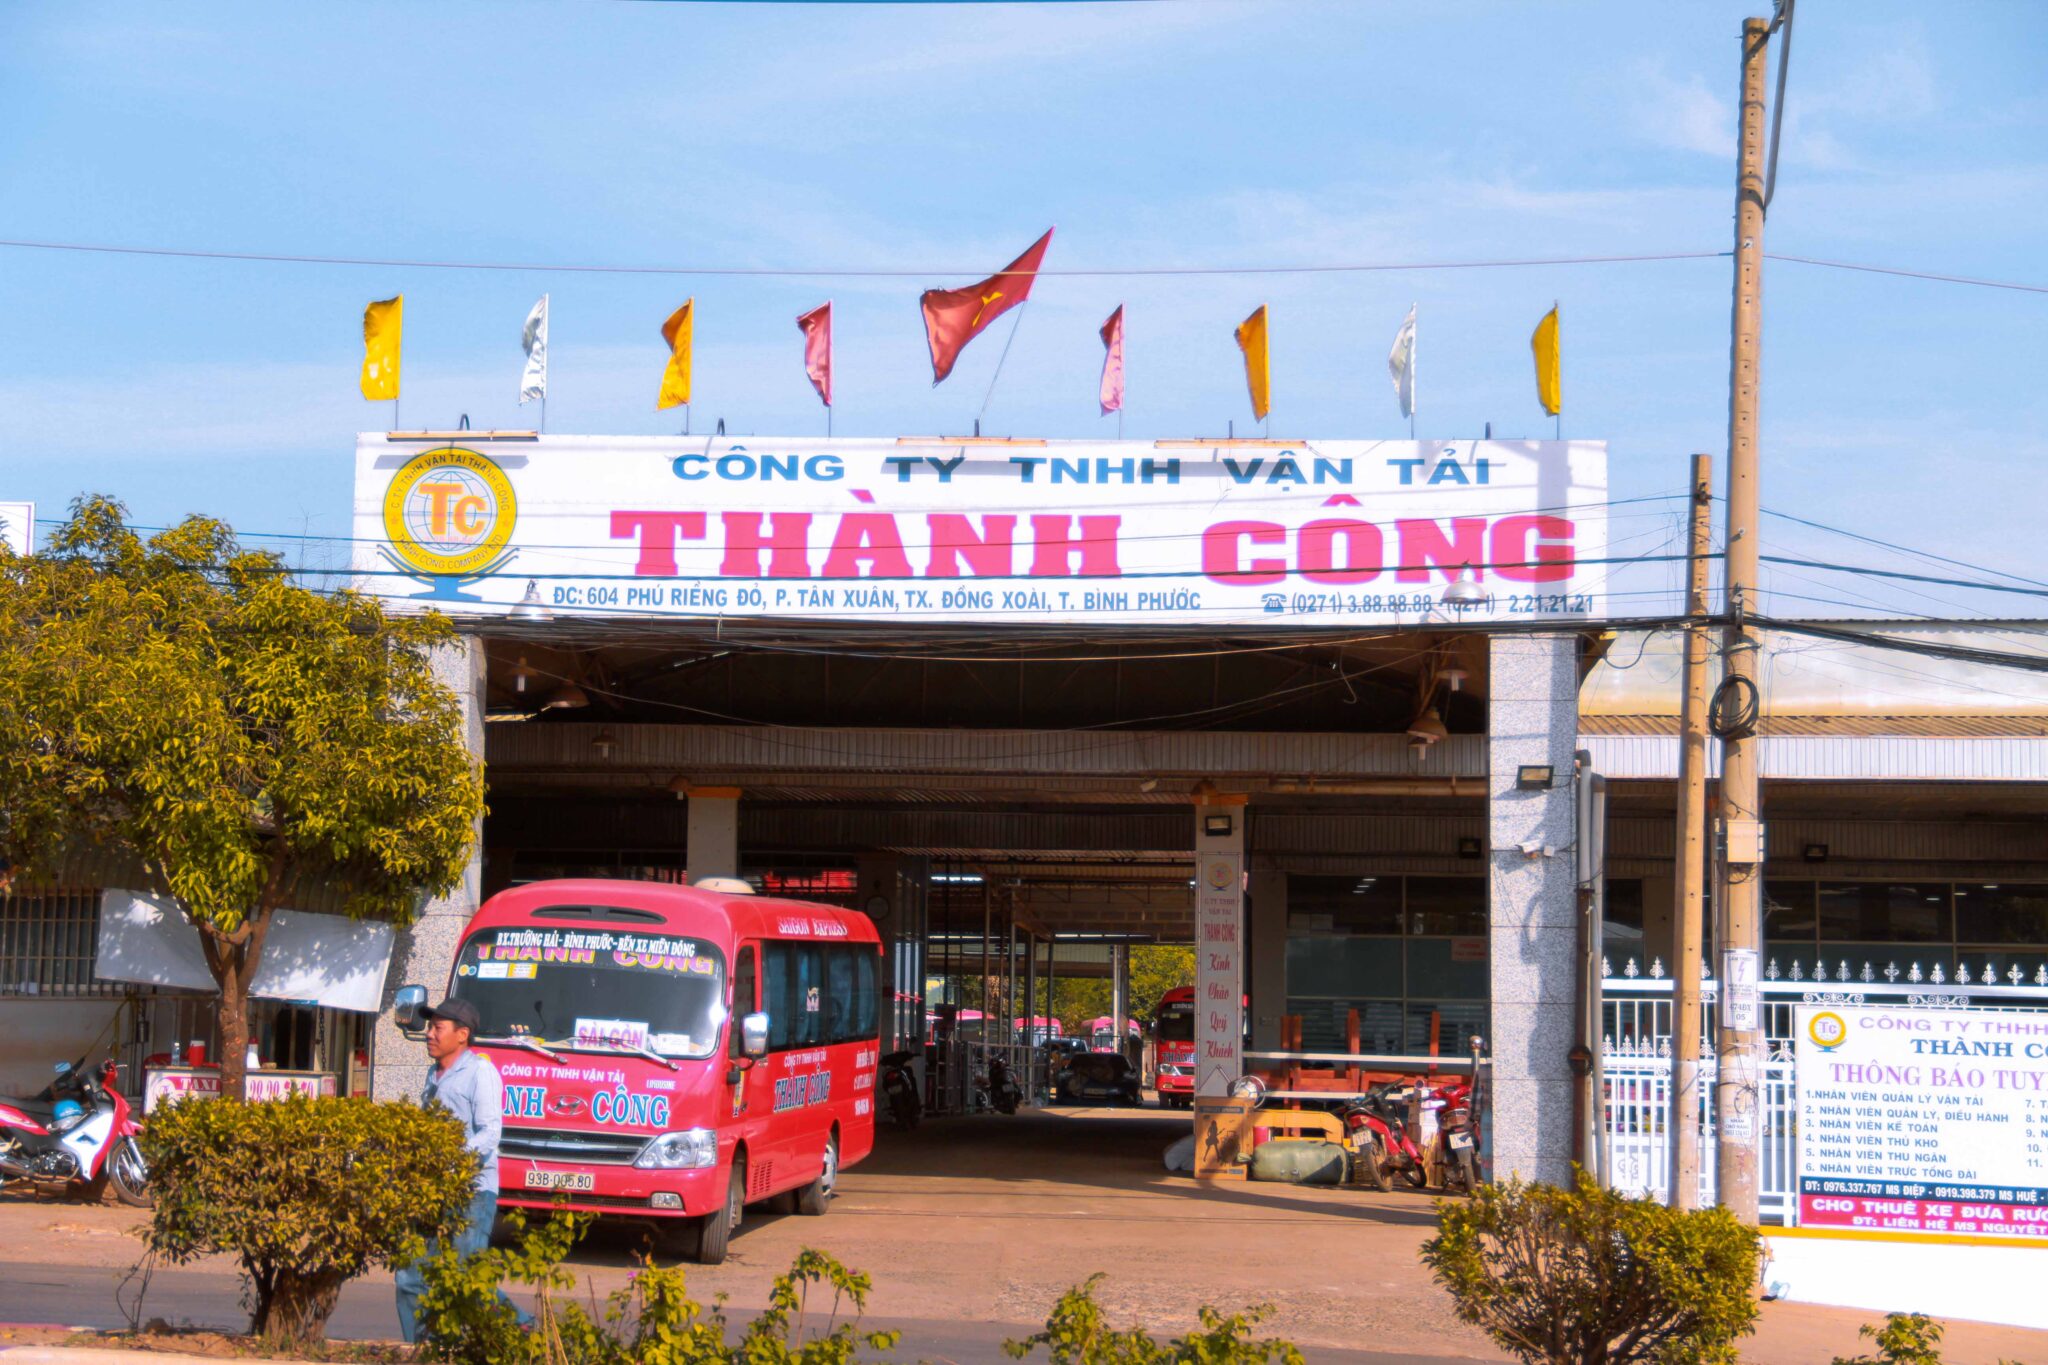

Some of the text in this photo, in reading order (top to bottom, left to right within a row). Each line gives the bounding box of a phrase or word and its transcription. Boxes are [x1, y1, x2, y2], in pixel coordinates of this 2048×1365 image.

[672, 445, 1490, 492] CÔNG TY TNHH VẬN TẢI
[610, 489, 1575, 587] THÀNH CÔNG
[553, 586, 583, 605] ĐC:
[587, 587, 619, 606] 604
[627, 584, 664, 606] PHÚ
[736, 584, 767, 610] ĐỎ,
[776, 589, 791, 607] P.
[799, 585, 835, 608] TÂN
[844, 586, 900, 612] XUÂN,
[905, 590, 933, 608] TX.
[941, 586, 994, 609] ĐỒNG
[1002, 587, 1052, 613] XOÀI,
[1059, 592, 1075, 609] T.
[1083, 588, 1129, 610] BÌNH
[1138, 587, 1201, 610] PHƯỚC
[1291, 591, 1343, 614] (0271)
[1347, 594, 1433, 613] 3.88.88.88
[1508, 594, 1594, 614] 2.21.21.21
[635, 939, 648, 952] XE
[1859, 1014, 1932, 1031] CÔNG
[1940, 1021, 1971, 1032] TY
[1910, 1036, 2014, 1057] THÀNH
[501, 1063, 625, 1084] CÔNG TY TNHH VẬN TẢI
[1829, 1059, 1921, 1086] THÔNG
[1930, 1062, 1985, 1088] BÁO
[180, 1077, 218, 1091] TAXI
[1851, 1091, 1877, 1102] VIÊN
[2025, 1100, 2035, 1108] 7.
[591, 1084, 670, 1129] CÔNG
[1805, 1105, 1815, 1114] 2.
[1819, 1105, 1850, 1115] NHÂN
[1855, 1105, 1882, 1117] VIÊN
[1977, 1110, 2009, 1123] HÀNH
[1805, 1119, 1815, 1128] 3.
[1819, 1119, 1850, 1129] NHÂN
[1855, 1119, 1882, 1130] VIÊN
[1908, 1121, 1938, 1133] TOÁN
[2025, 1115, 2035, 1123] 8.
[1805, 1134, 1815, 1142] 4.
[1819, 1133, 1850, 1144] NHÂN
[1855, 1134, 1882, 1146] VIÊN
[1915, 1139, 1938, 1148] KHO
[2025, 1129, 2036, 1138] 9.
[1805, 1148, 1947, 1163] 5. NHÂN VIÊN THU NGÂN
[2027, 1144, 2043, 1152] 10.
[1805, 1163, 1815, 1172] 6.
[1820, 1162, 1850, 1173] NHÂN
[1856, 1164, 1882, 1175] VIÊN
[1958, 1167, 1977, 1180] ĐÀI
[2027, 1159, 2043, 1168] 11.
[1805, 1180, 2037, 1205] ĐT: 0976.337.767 MS ĐIỆP 0919.398.379 MS HUỆ
[1812, 1198, 1855, 1212] CHO
[1862, 1200, 1917, 1215] THUÊ
[1925, 1203, 1953, 1217] XE
[1961, 1205, 2004, 1220] ĐƯA
[1852, 1216, 2048, 1236] ĐT: LIÊN HỆ MS NGUYỆT
